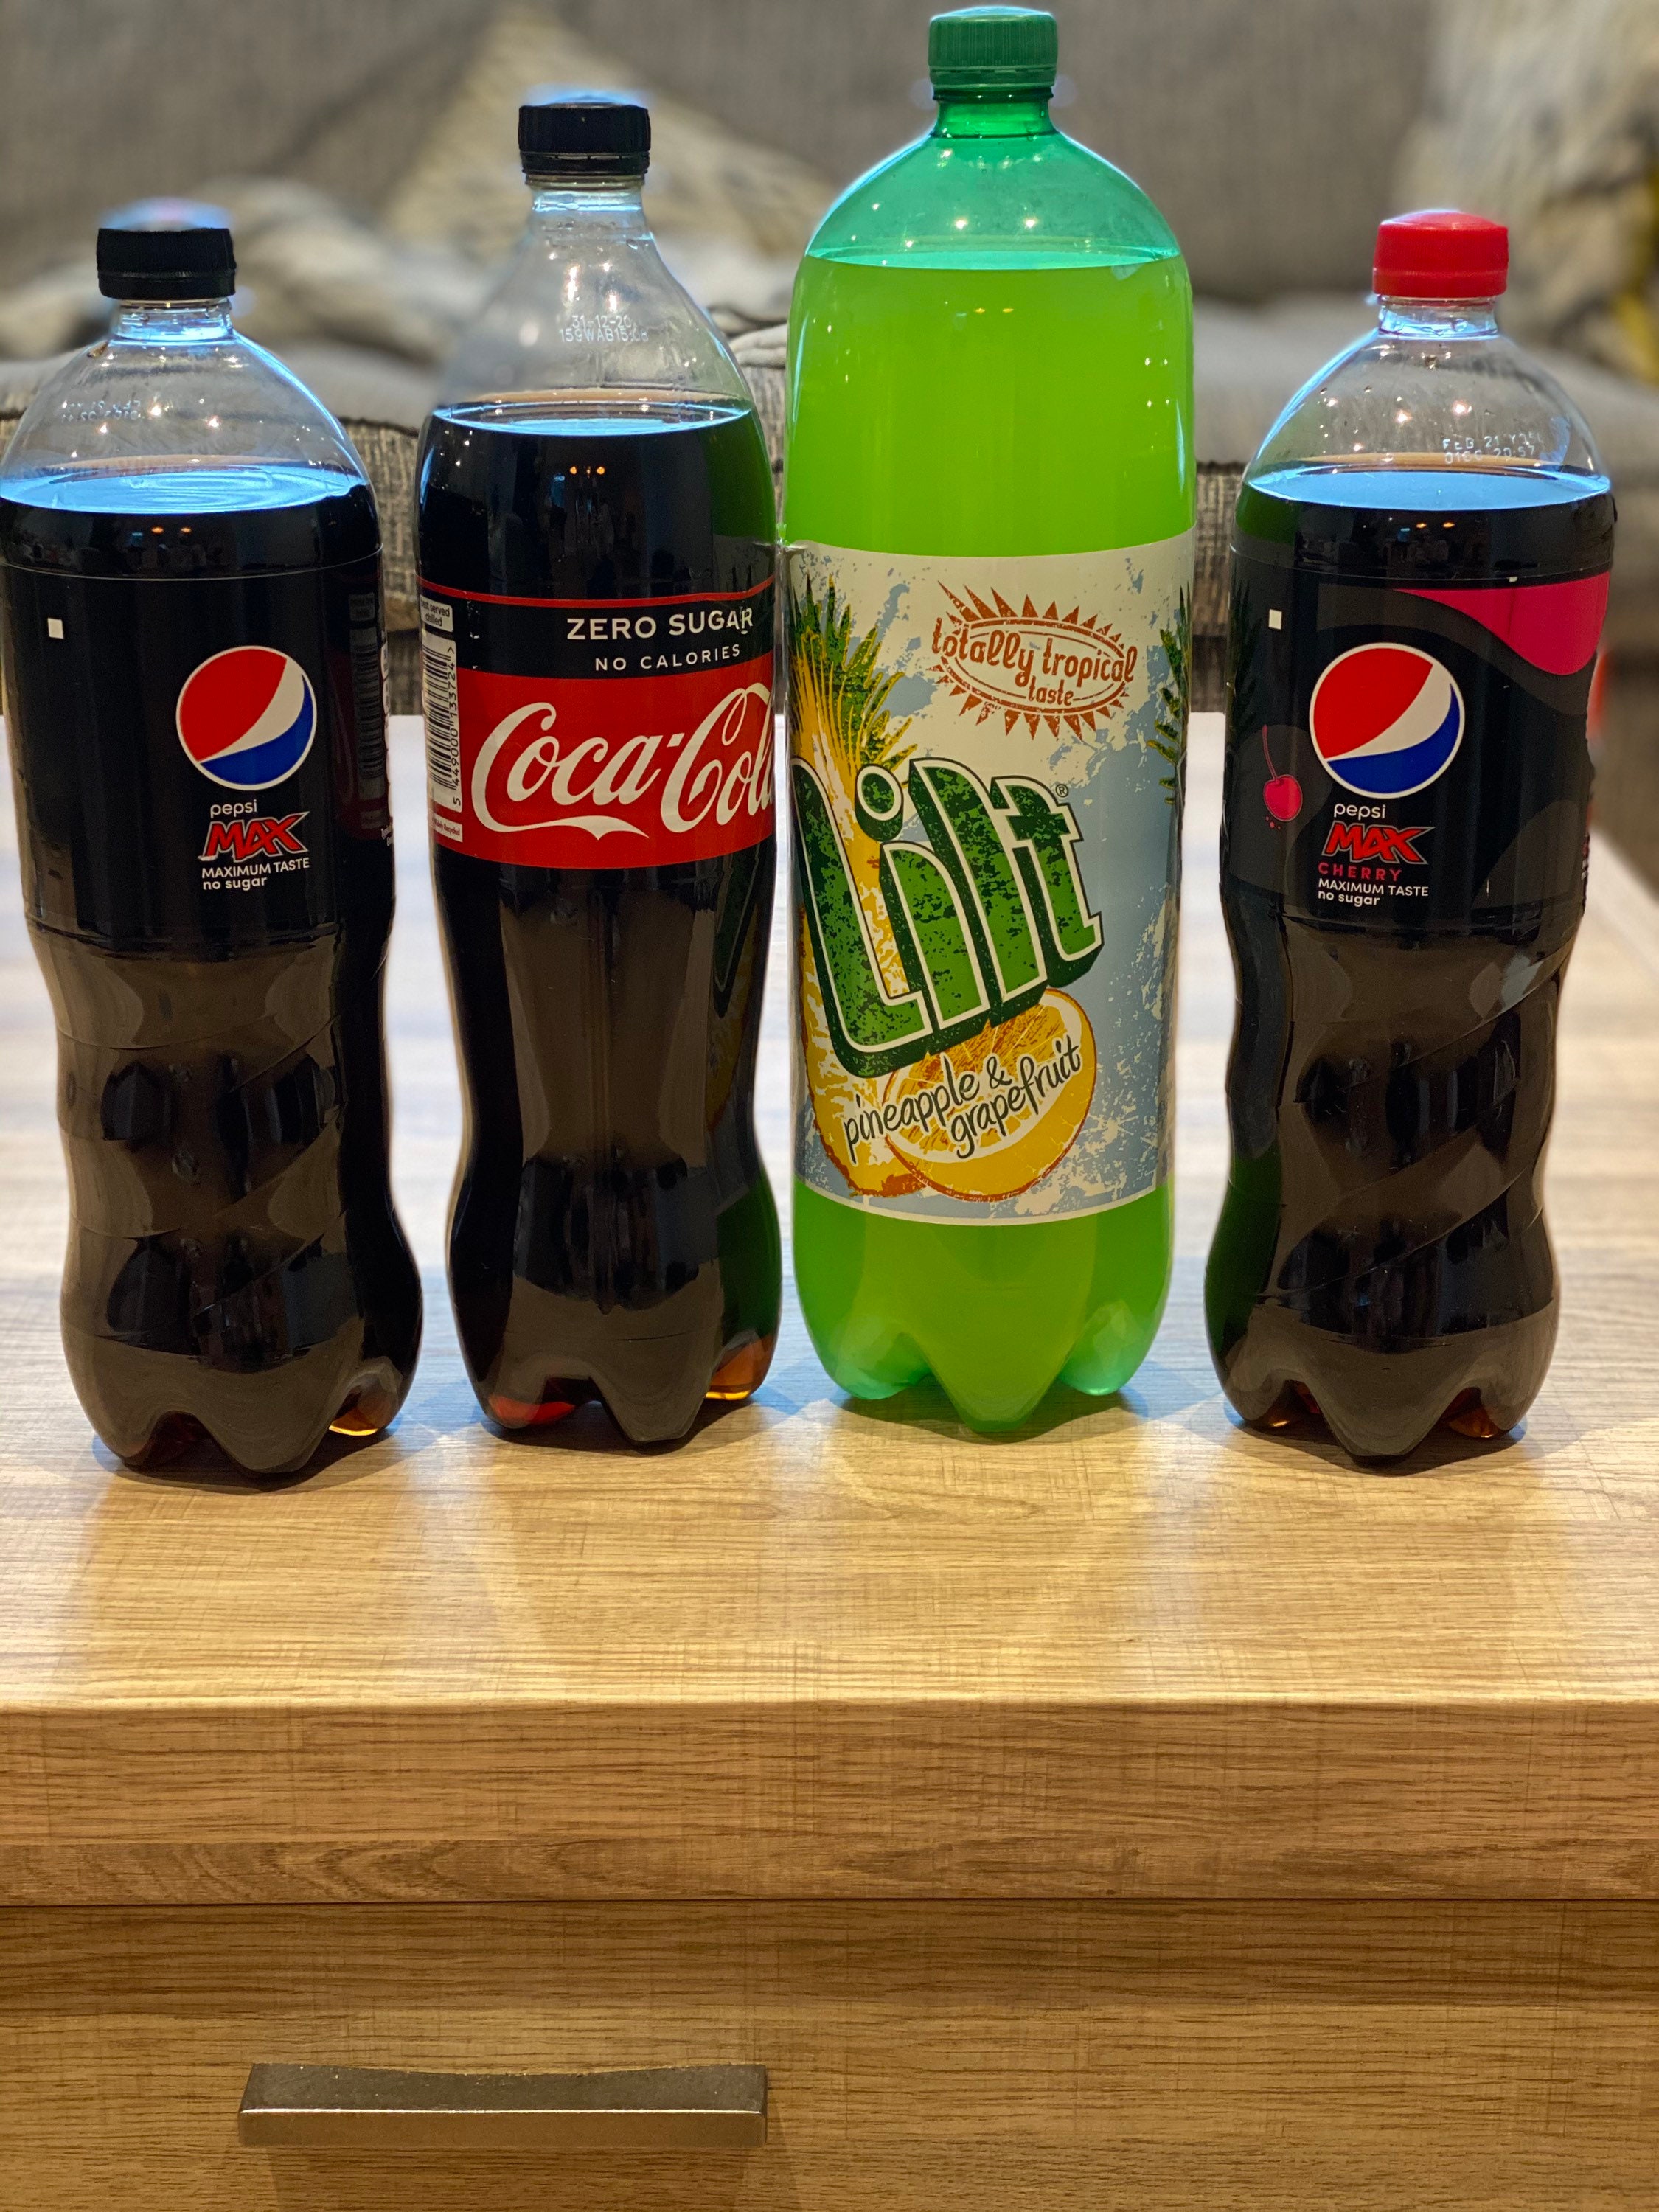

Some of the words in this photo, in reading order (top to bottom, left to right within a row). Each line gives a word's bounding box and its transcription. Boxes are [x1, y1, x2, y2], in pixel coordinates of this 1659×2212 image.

[567, 616, 657, 640] ZERO
[669, 608, 754, 636] SUGAR
[595, 658, 627, 671] NO
[640, 644, 740, 669] CALORIES
[931, 617, 1035, 687] totally
[1042, 637, 1138, 687] tropical
[1028, 679, 1074, 706] taste
[210, 799, 257, 818] pepsi
[1333, 803, 1386, 821] pepsi
[197, 811, 310, 863] MAX
[1321, 820, 1436, 865] MAX
[201, 863, 271, 879] MAXIMUM
[273, 858, 310, 873] TASTE
[1318, 862, 1402, 882] CHERRY
[203, 880, 220, 890] no
[225, 877, 268, 891] sugar
[1318, 877, 1385, 895] MAXIMUM
[1388, 886, 1429, 897] TASTE
[1318, 890, 1335, 901] no
[1338, 894, 1380, 908] sugar
[790, 755, 1105, 1078] Lilt
[843, 1052, 979, 1164] pineapple
[987, 1056, 1013, 1089] &
[950, 1034, 1082, 1159] grapefruit
